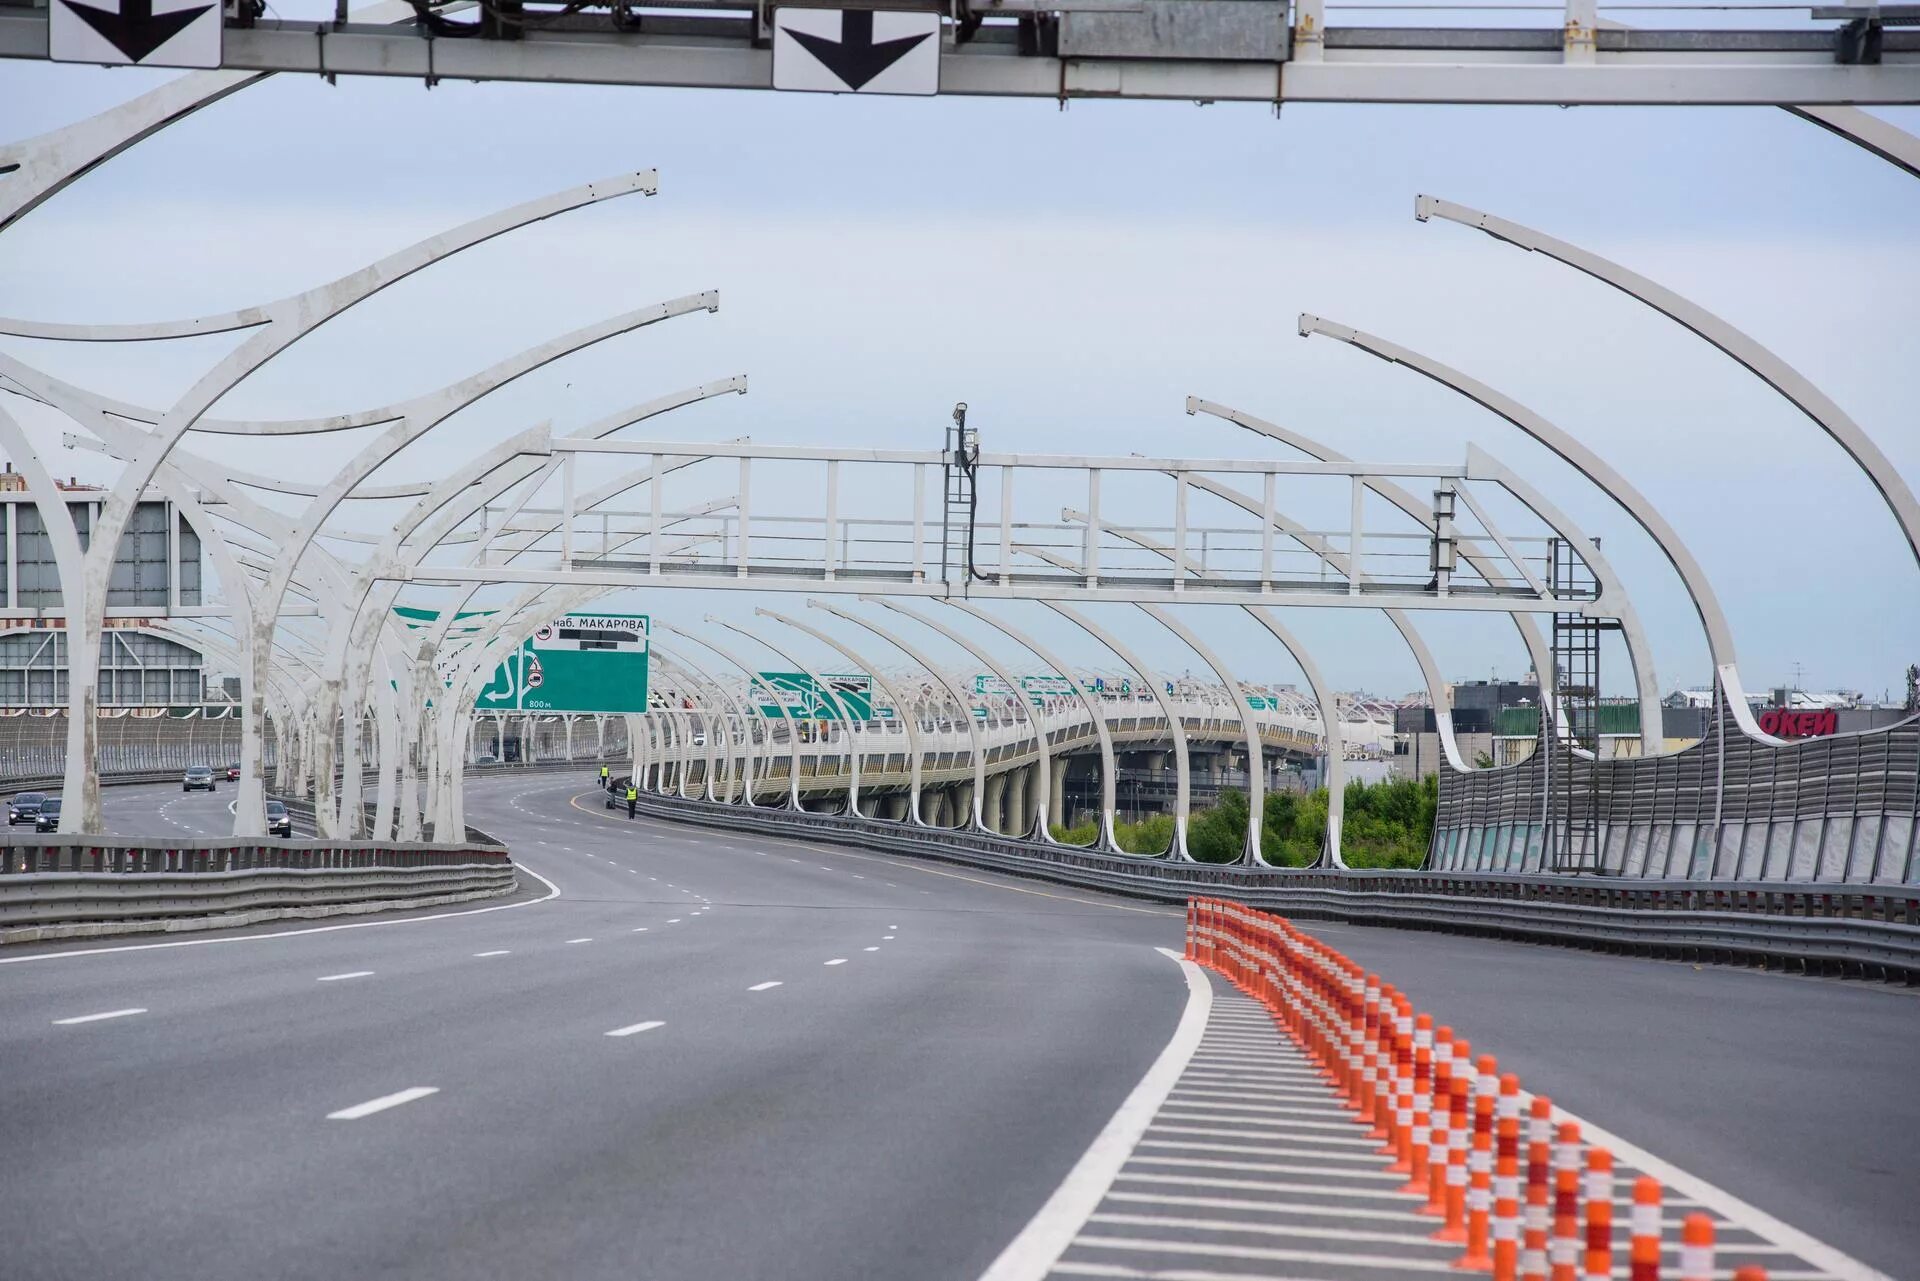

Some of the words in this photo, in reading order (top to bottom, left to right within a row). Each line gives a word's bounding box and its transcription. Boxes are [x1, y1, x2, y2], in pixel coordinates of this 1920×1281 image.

[553, 617, 575, 628] наб.
[579, 618, 644, 629] МАКАРОВА
[529, 700, 544, 708] 800
